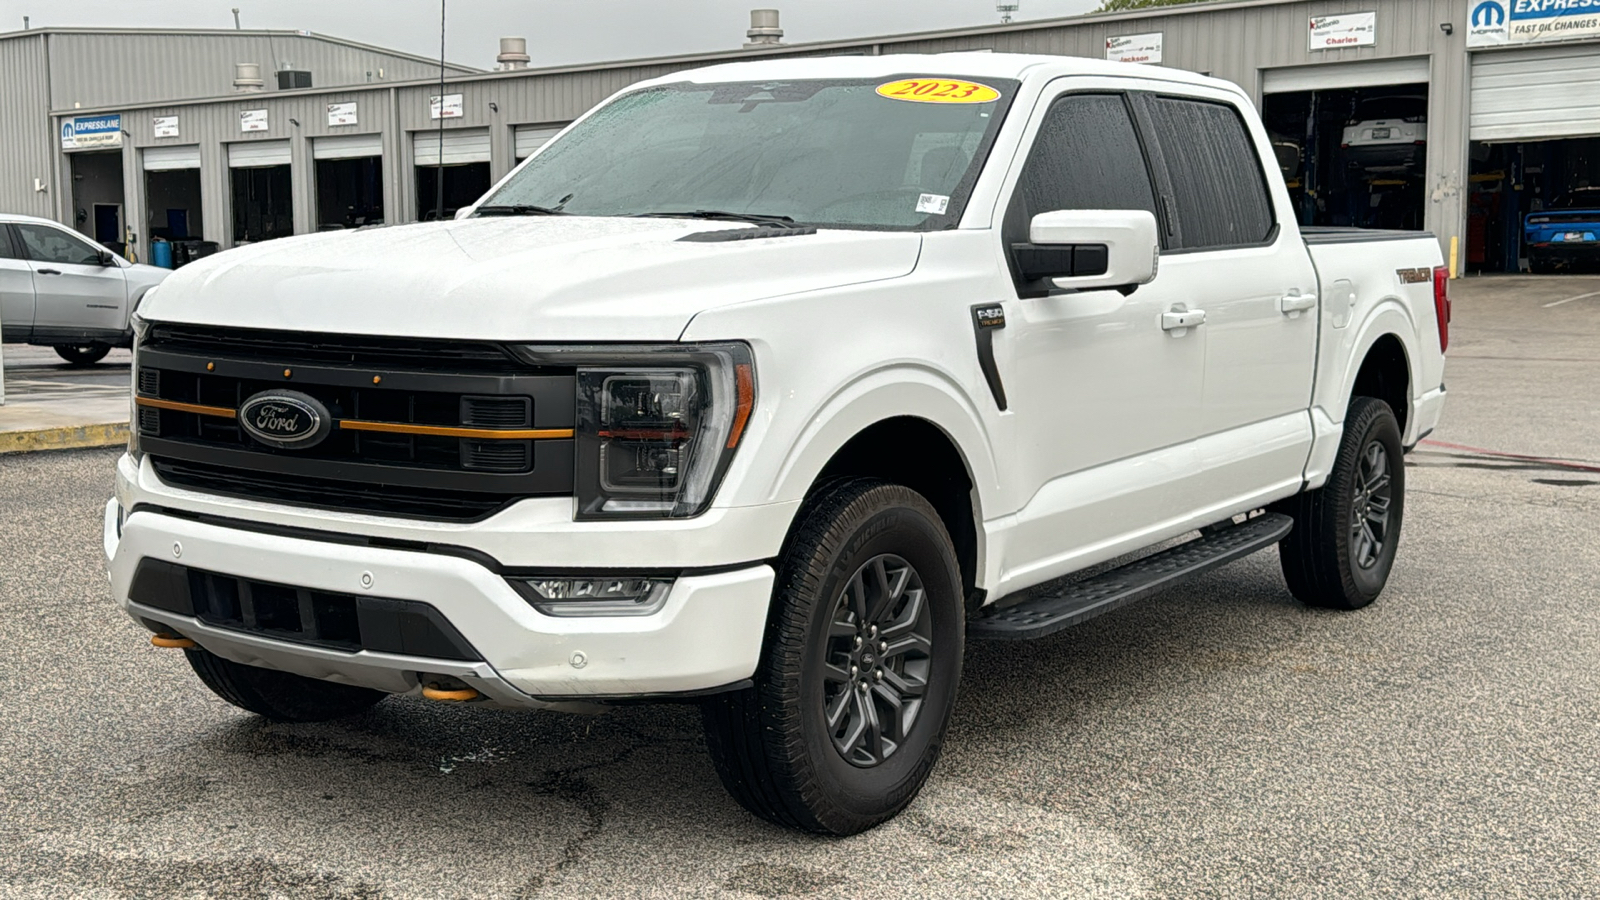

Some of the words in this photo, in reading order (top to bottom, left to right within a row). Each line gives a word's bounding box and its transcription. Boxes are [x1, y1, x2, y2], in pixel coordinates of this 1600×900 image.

[1314, 19, 1340, 30] Antonio
[1514, 24, 1537, 34] FAST
[1538, 22, 1552, 33] OIL
[1554, 19, 1598, 31] CHANGES
[1325, 37, 1358, 45] Charles
[1120, 55, 1149, 63] Jackson
[891, 82, 980, 98] 2023
[75, 119, 120, 131] EXPRESSLANE
[1396, 266, 1433, 285] TREMOR
[977, 307, 1003, 320] F-150
[256, 404, 299, 432] Ford
[852, 515, 897, 553] MICHELIN
